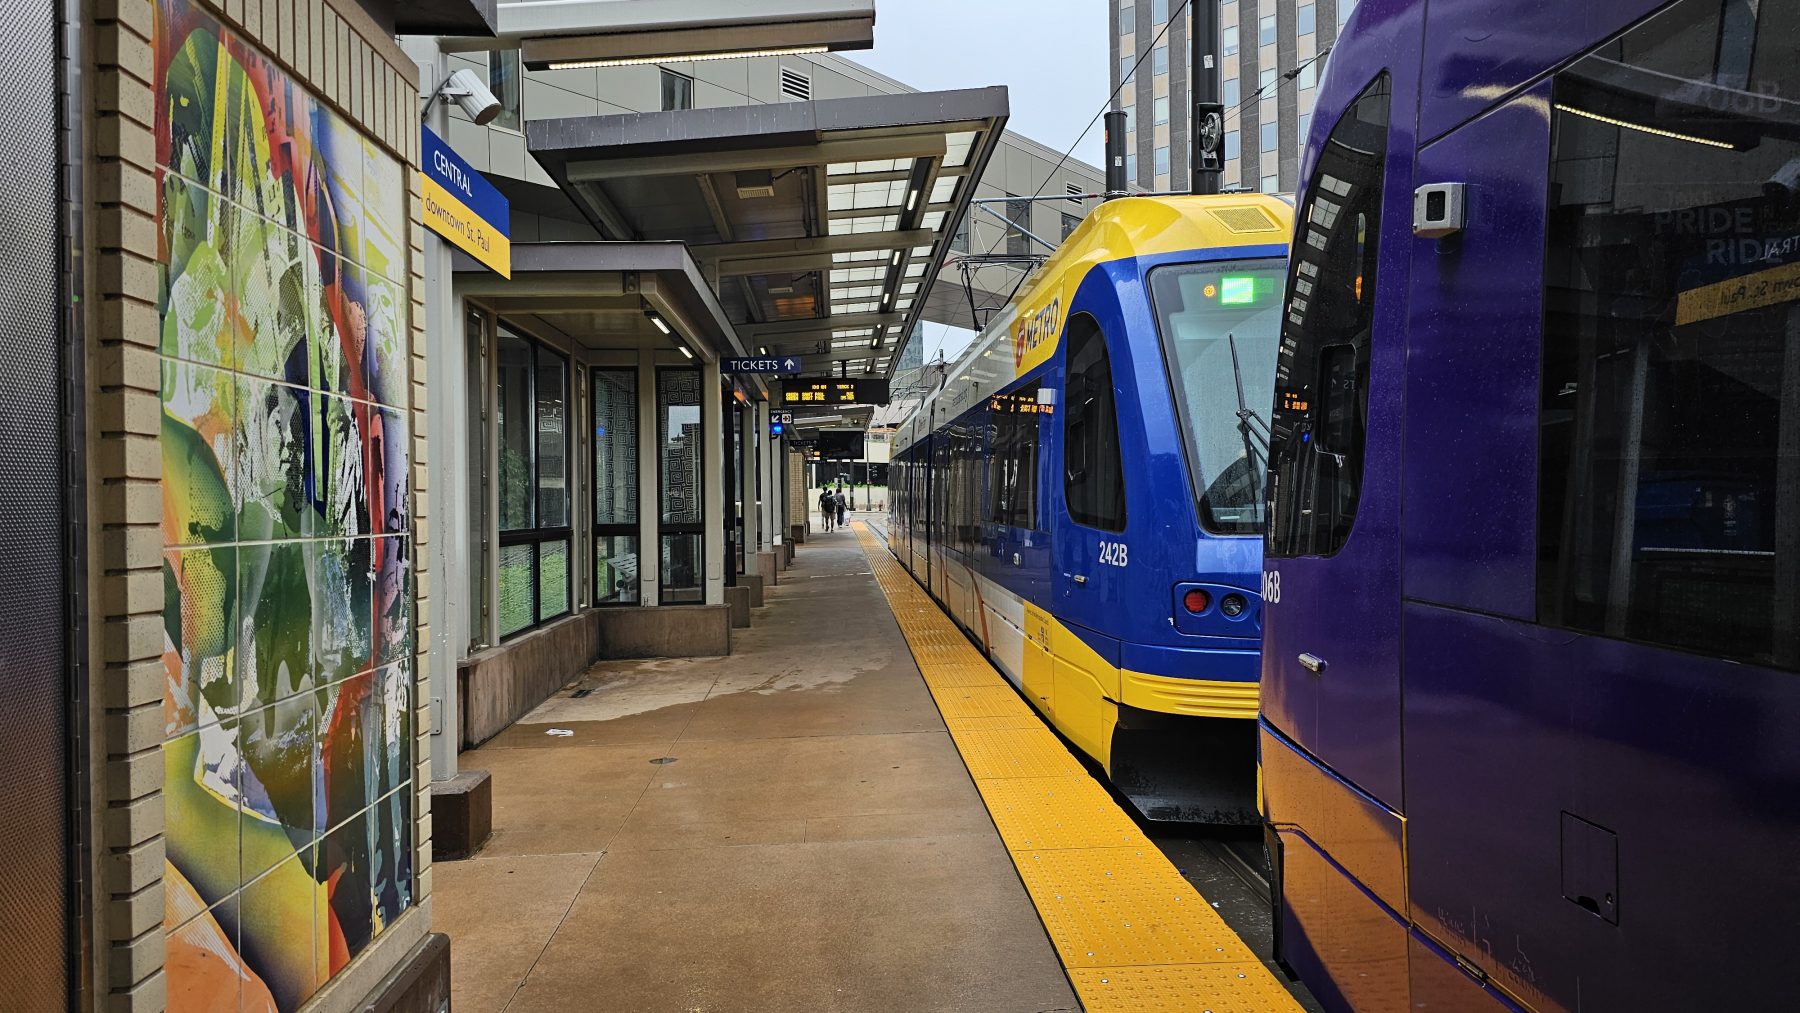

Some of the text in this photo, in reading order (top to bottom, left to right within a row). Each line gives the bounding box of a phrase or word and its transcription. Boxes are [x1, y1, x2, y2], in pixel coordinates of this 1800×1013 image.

[434, 150, 473, 197] CENTRAL
[425, 192, 490, 253] downtown St. Paul
[1654, 206, 1754, 235] PRIDE
[1705, 237, 1783, 265] RIDE
[1025, 297, 1059, 353] METRO
[730, 360, 778, 371] TICKETS
[1099, 540, 1128, 567] 242B
[1262, 570, 1281, 604] 06B
